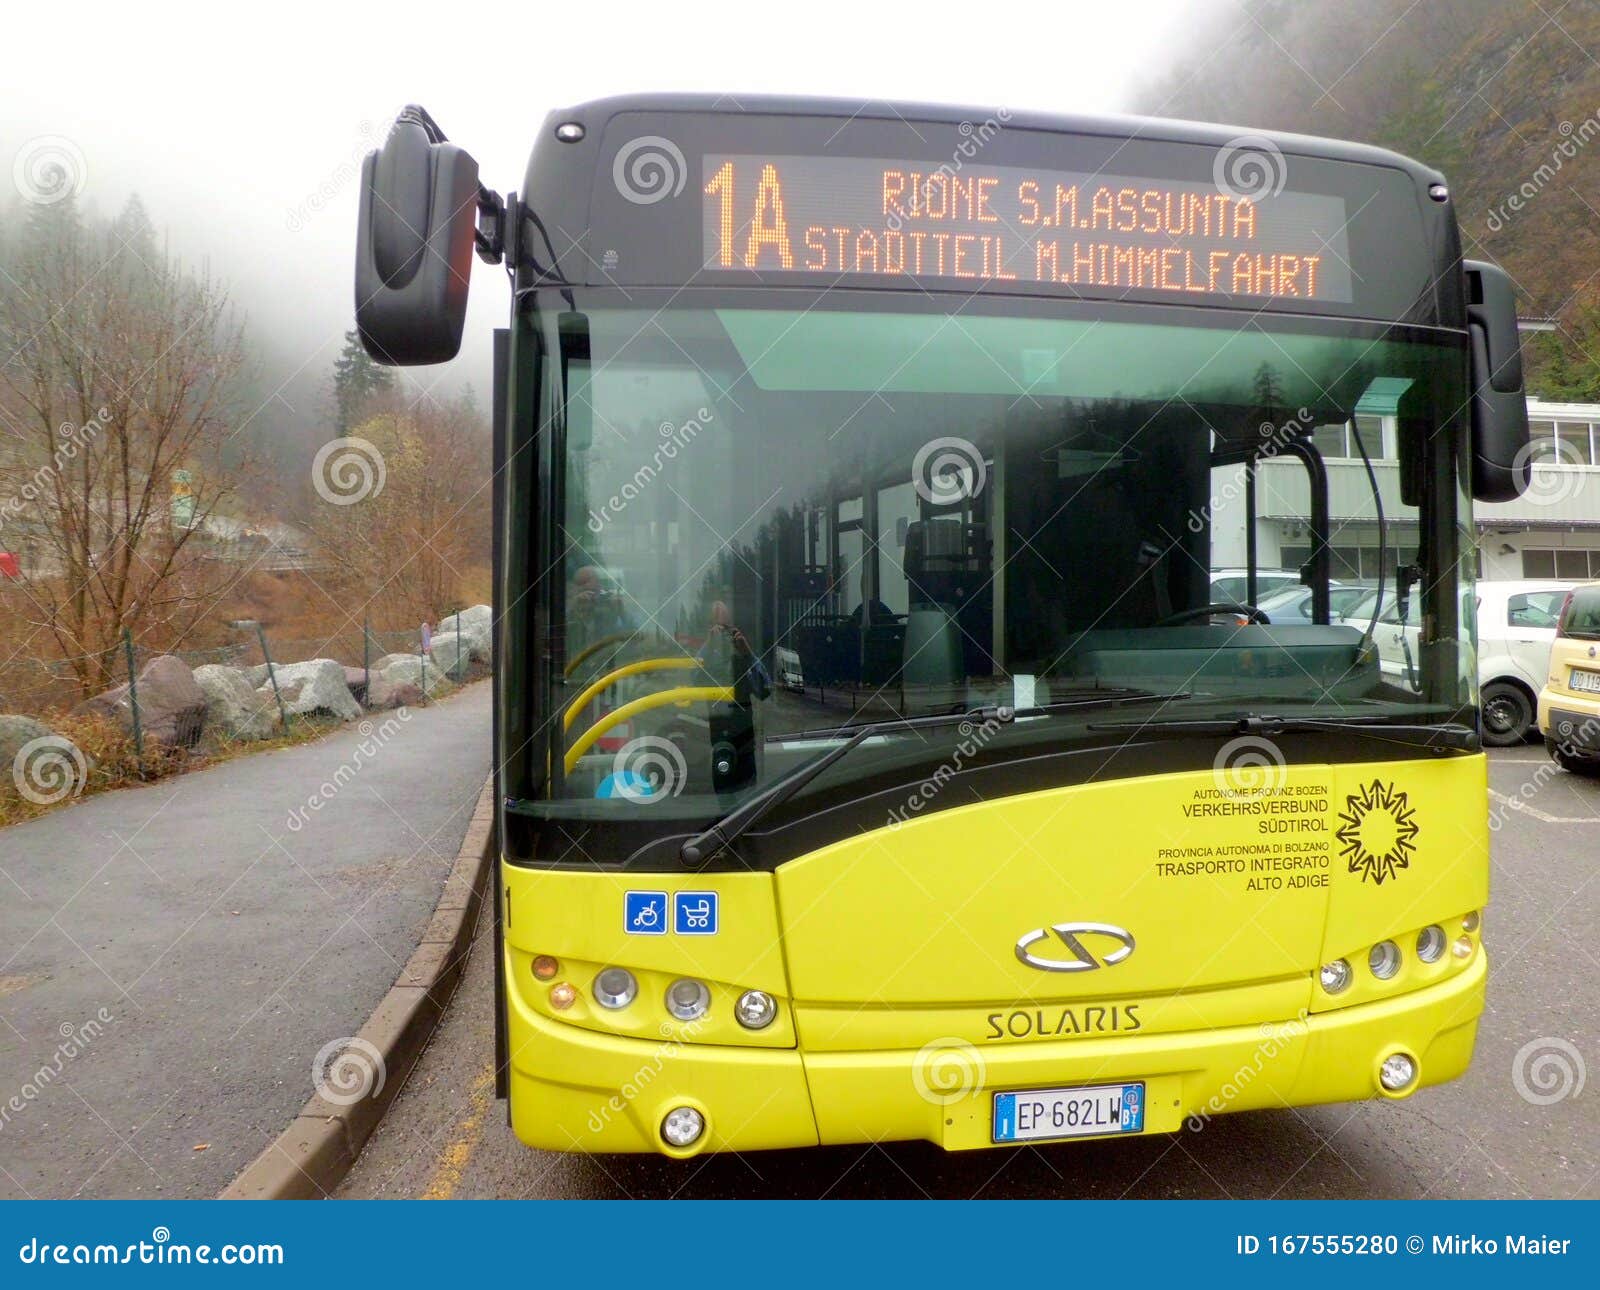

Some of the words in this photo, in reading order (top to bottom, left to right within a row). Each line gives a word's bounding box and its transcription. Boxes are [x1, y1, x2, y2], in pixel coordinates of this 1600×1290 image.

[882, 170, 999, 223] RIONE
[1018, 181, 1256, 240] S.M.ASSUNTA
[704, 162, 793, 269] 1A
[804, 226, 1016, 280] STADTTEIL
[1036, 241, 1321, 298] M.HIMMELFAHRT
[1193, 787, 1249, 799] AUTONOME
[1251, 786, 1294, 797] PROVINZ
[1296, 785, 1328, 796] BOZEN
[1182, 799, 1329, 818] VERKEHRSVERBUND
[1258, 818, 1329, 834] SÜDTIROL
[1158, 847, 1213, 859] PROVINCIA
[1215, 845, 1271, 857] AUTONOMA
[1273, 843, 1283, 854] DI
[1285, 841, 1329, 853] BOLZANO
[1156, 859, 1246, 877] TRASPORTO
[1250, 855, 1330, 872] INTEGRATO
[1246, 876, 1283, 891] ALTO
[1286, 874, 1330, 889] ADIGE
[986, 1005, 1142, 1040] SOLARIS
